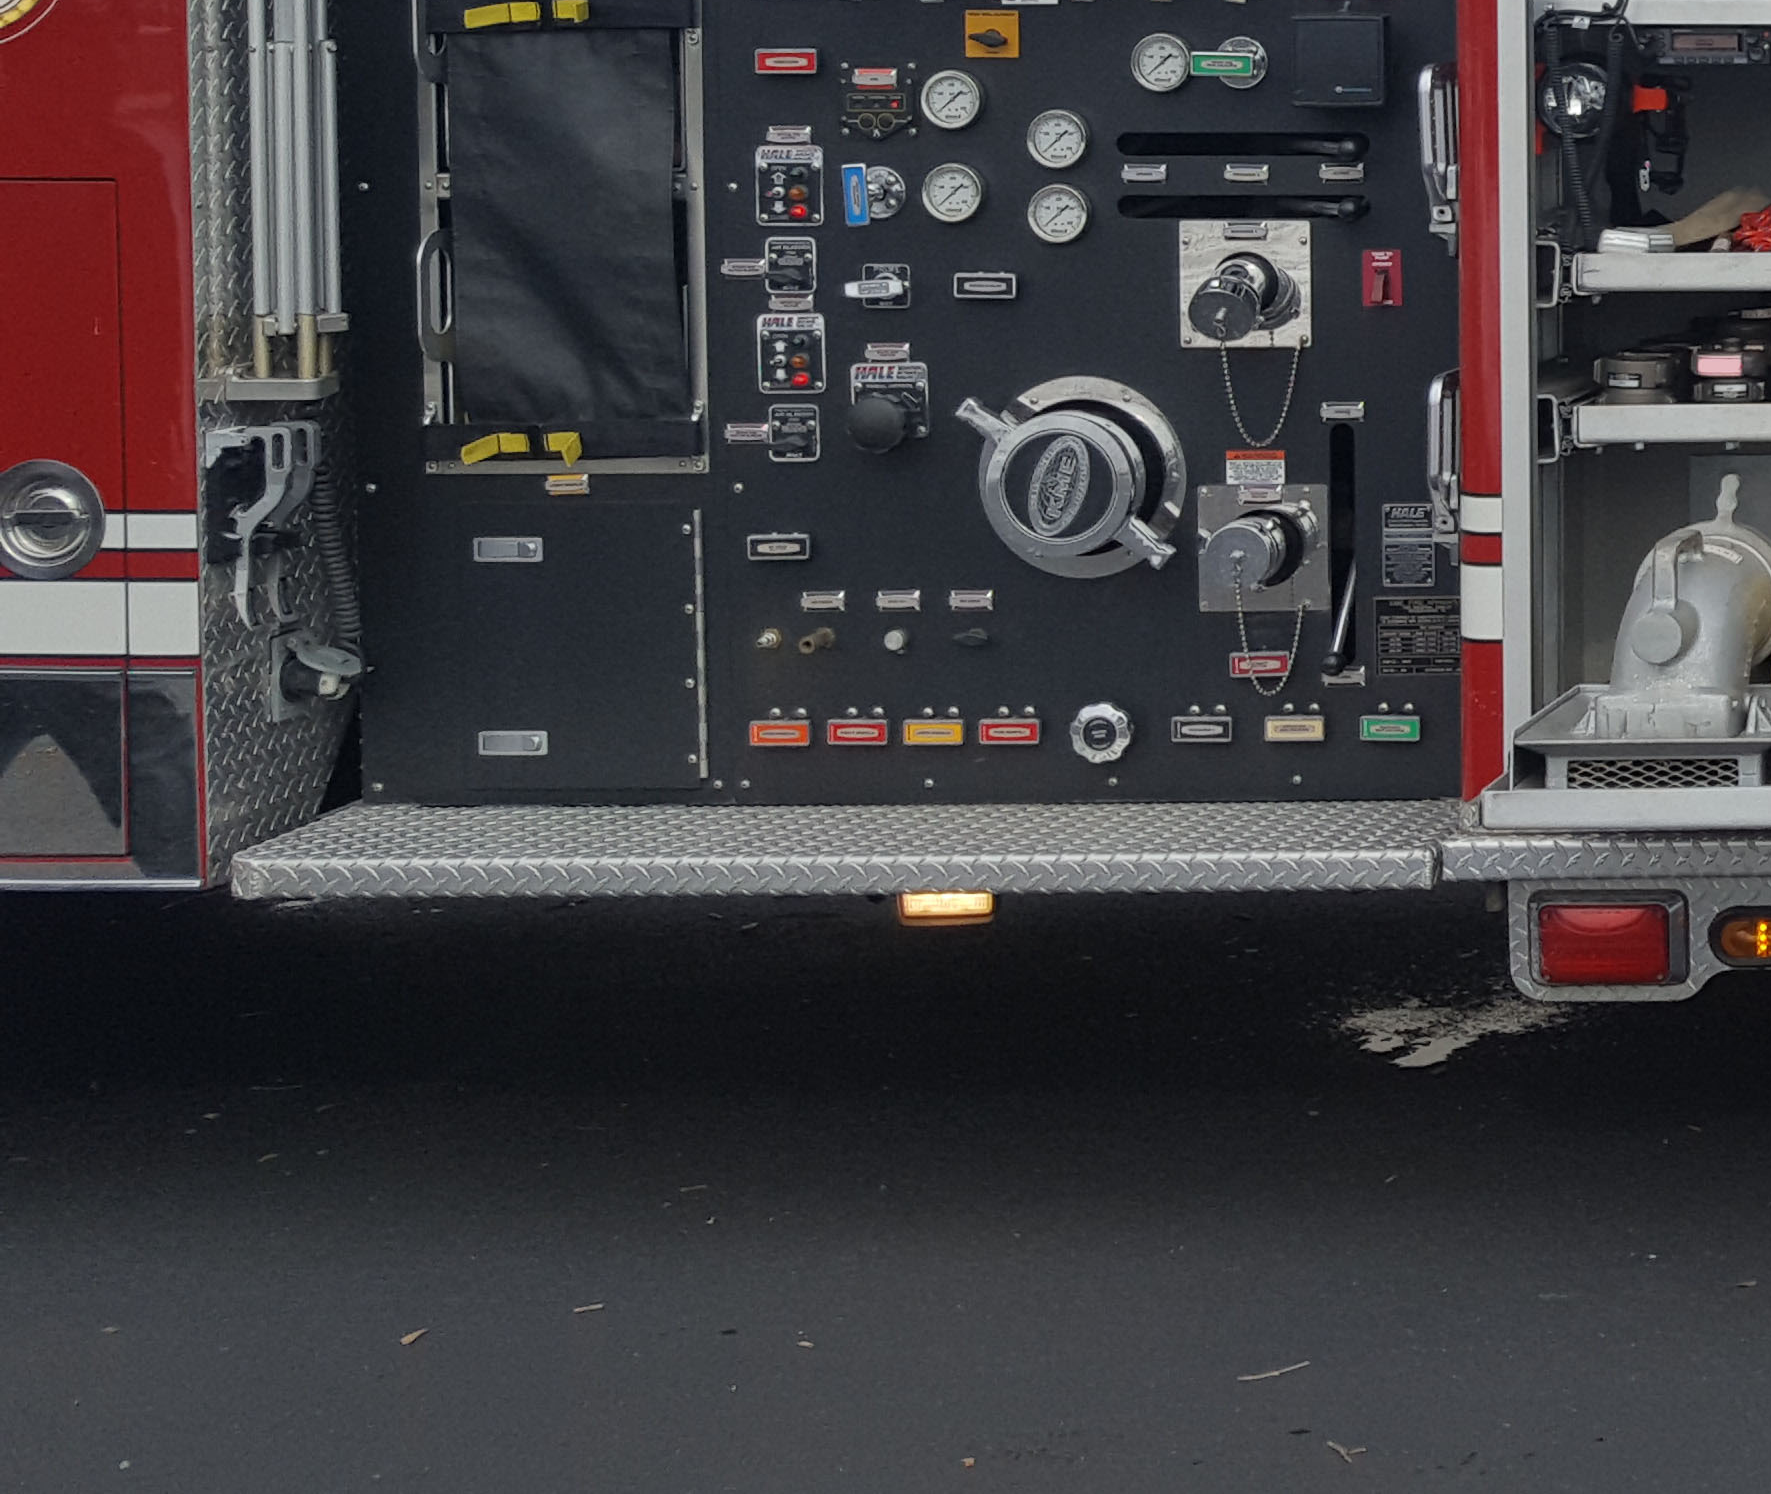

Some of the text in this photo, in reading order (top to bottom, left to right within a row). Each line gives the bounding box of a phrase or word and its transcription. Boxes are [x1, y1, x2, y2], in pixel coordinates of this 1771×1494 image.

[761, 149, 792, 160] HALE
[762, 317, 794, 328] HALE
[855, 366, 896, 380] HALE
[1390, 507, 1426, 519] HALE
